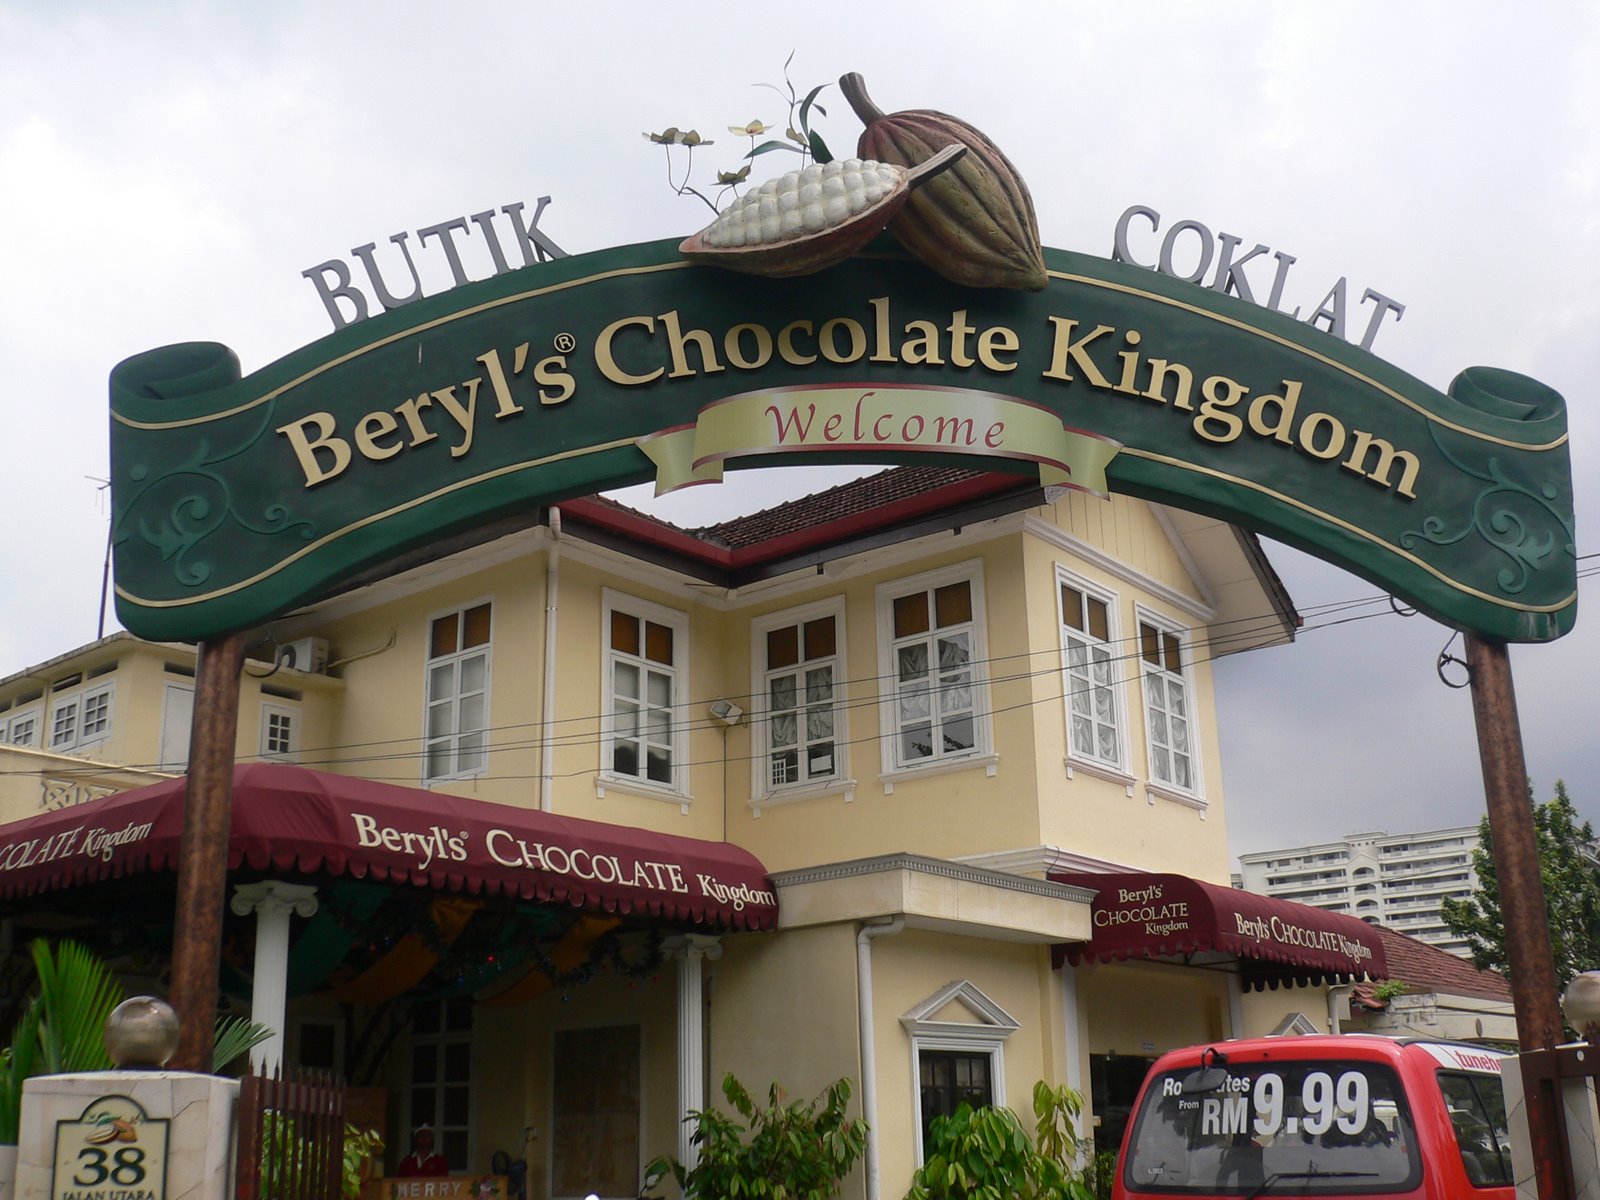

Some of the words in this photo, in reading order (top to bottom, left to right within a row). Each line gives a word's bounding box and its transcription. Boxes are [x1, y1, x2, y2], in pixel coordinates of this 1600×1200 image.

[301, 195, 573, 333] BUTIK
[1111, 204, 1407, 353] COKLAT
[593, 296, 1021, 386] Chocolate
[1041, 315, 1423, 501] Kingdom
[764, 391, 1006, 449] Welcome
[77, 822, 153, 862] Kingdom
[485, 828, 689, 895] CHOCOLATE
[696, 873, 777, 912] Kingdom
[1093, 902, 1190, 927] CHOCOLATE
[1144, 920, 1190, 936] Kingdom
[1270, 916, 1339, 952] CHOCOLATE
[1336, 933, 1373, 964] Kingdom
[1454, 1050, 1502, 1072] tuneh
[1178, 1100, 1200, 1111] From
[73, 1147, 146, 1187] 38
[62, 1191, 104, 1200] JALAN
[109, 1190, 155, 1200] UTARA
[397, 1182, 462, 1198] MERRY
